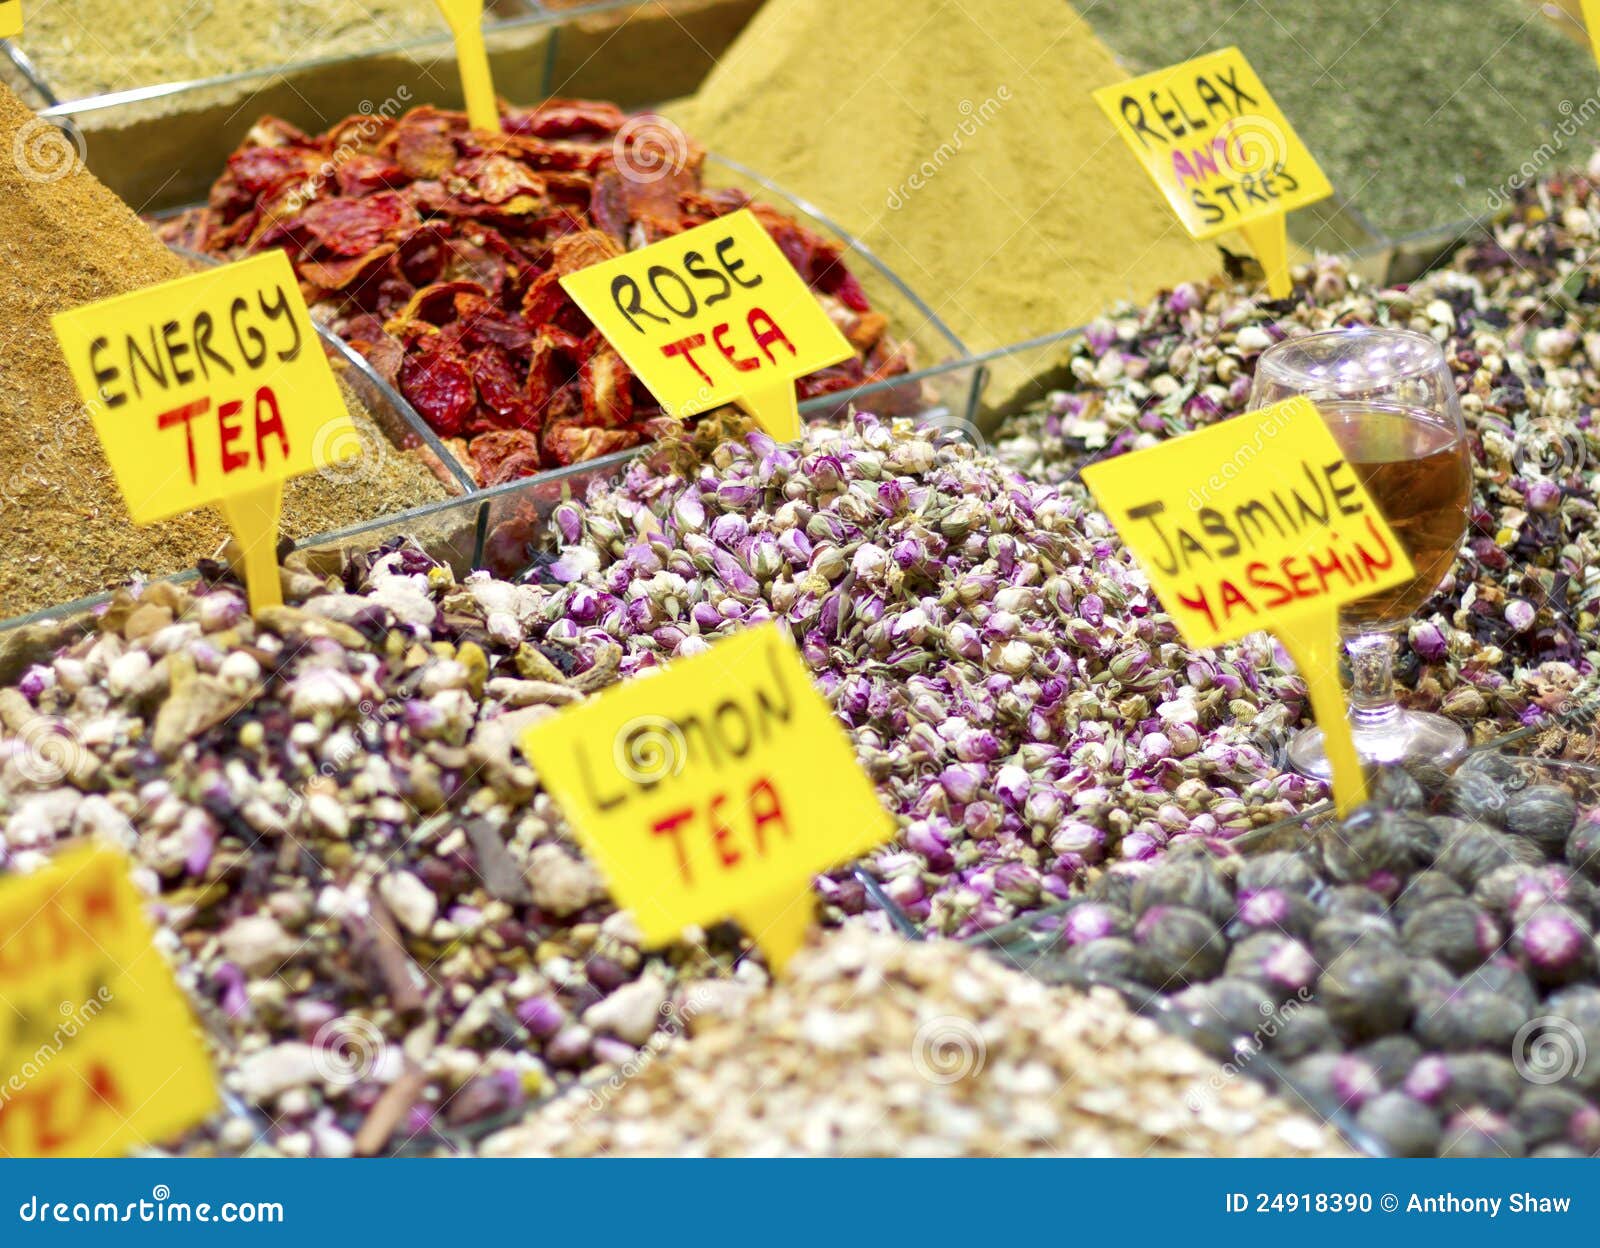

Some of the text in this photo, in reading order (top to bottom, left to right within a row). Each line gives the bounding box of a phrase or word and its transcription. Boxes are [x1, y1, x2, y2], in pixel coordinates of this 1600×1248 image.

[1119, 66, 1259, 148] RELAX
[1191, 161, 1298, 224] STRES
[610, 236, 763, 335] ROSE
[89, 285, 300, 409] ENERGY
[660, 307, 797, 388] TEA
[157, 386, 290, 485] TEA
[1126, 460, 1364, 577] JASMINE
[651, 776, 792, 888] TEA
